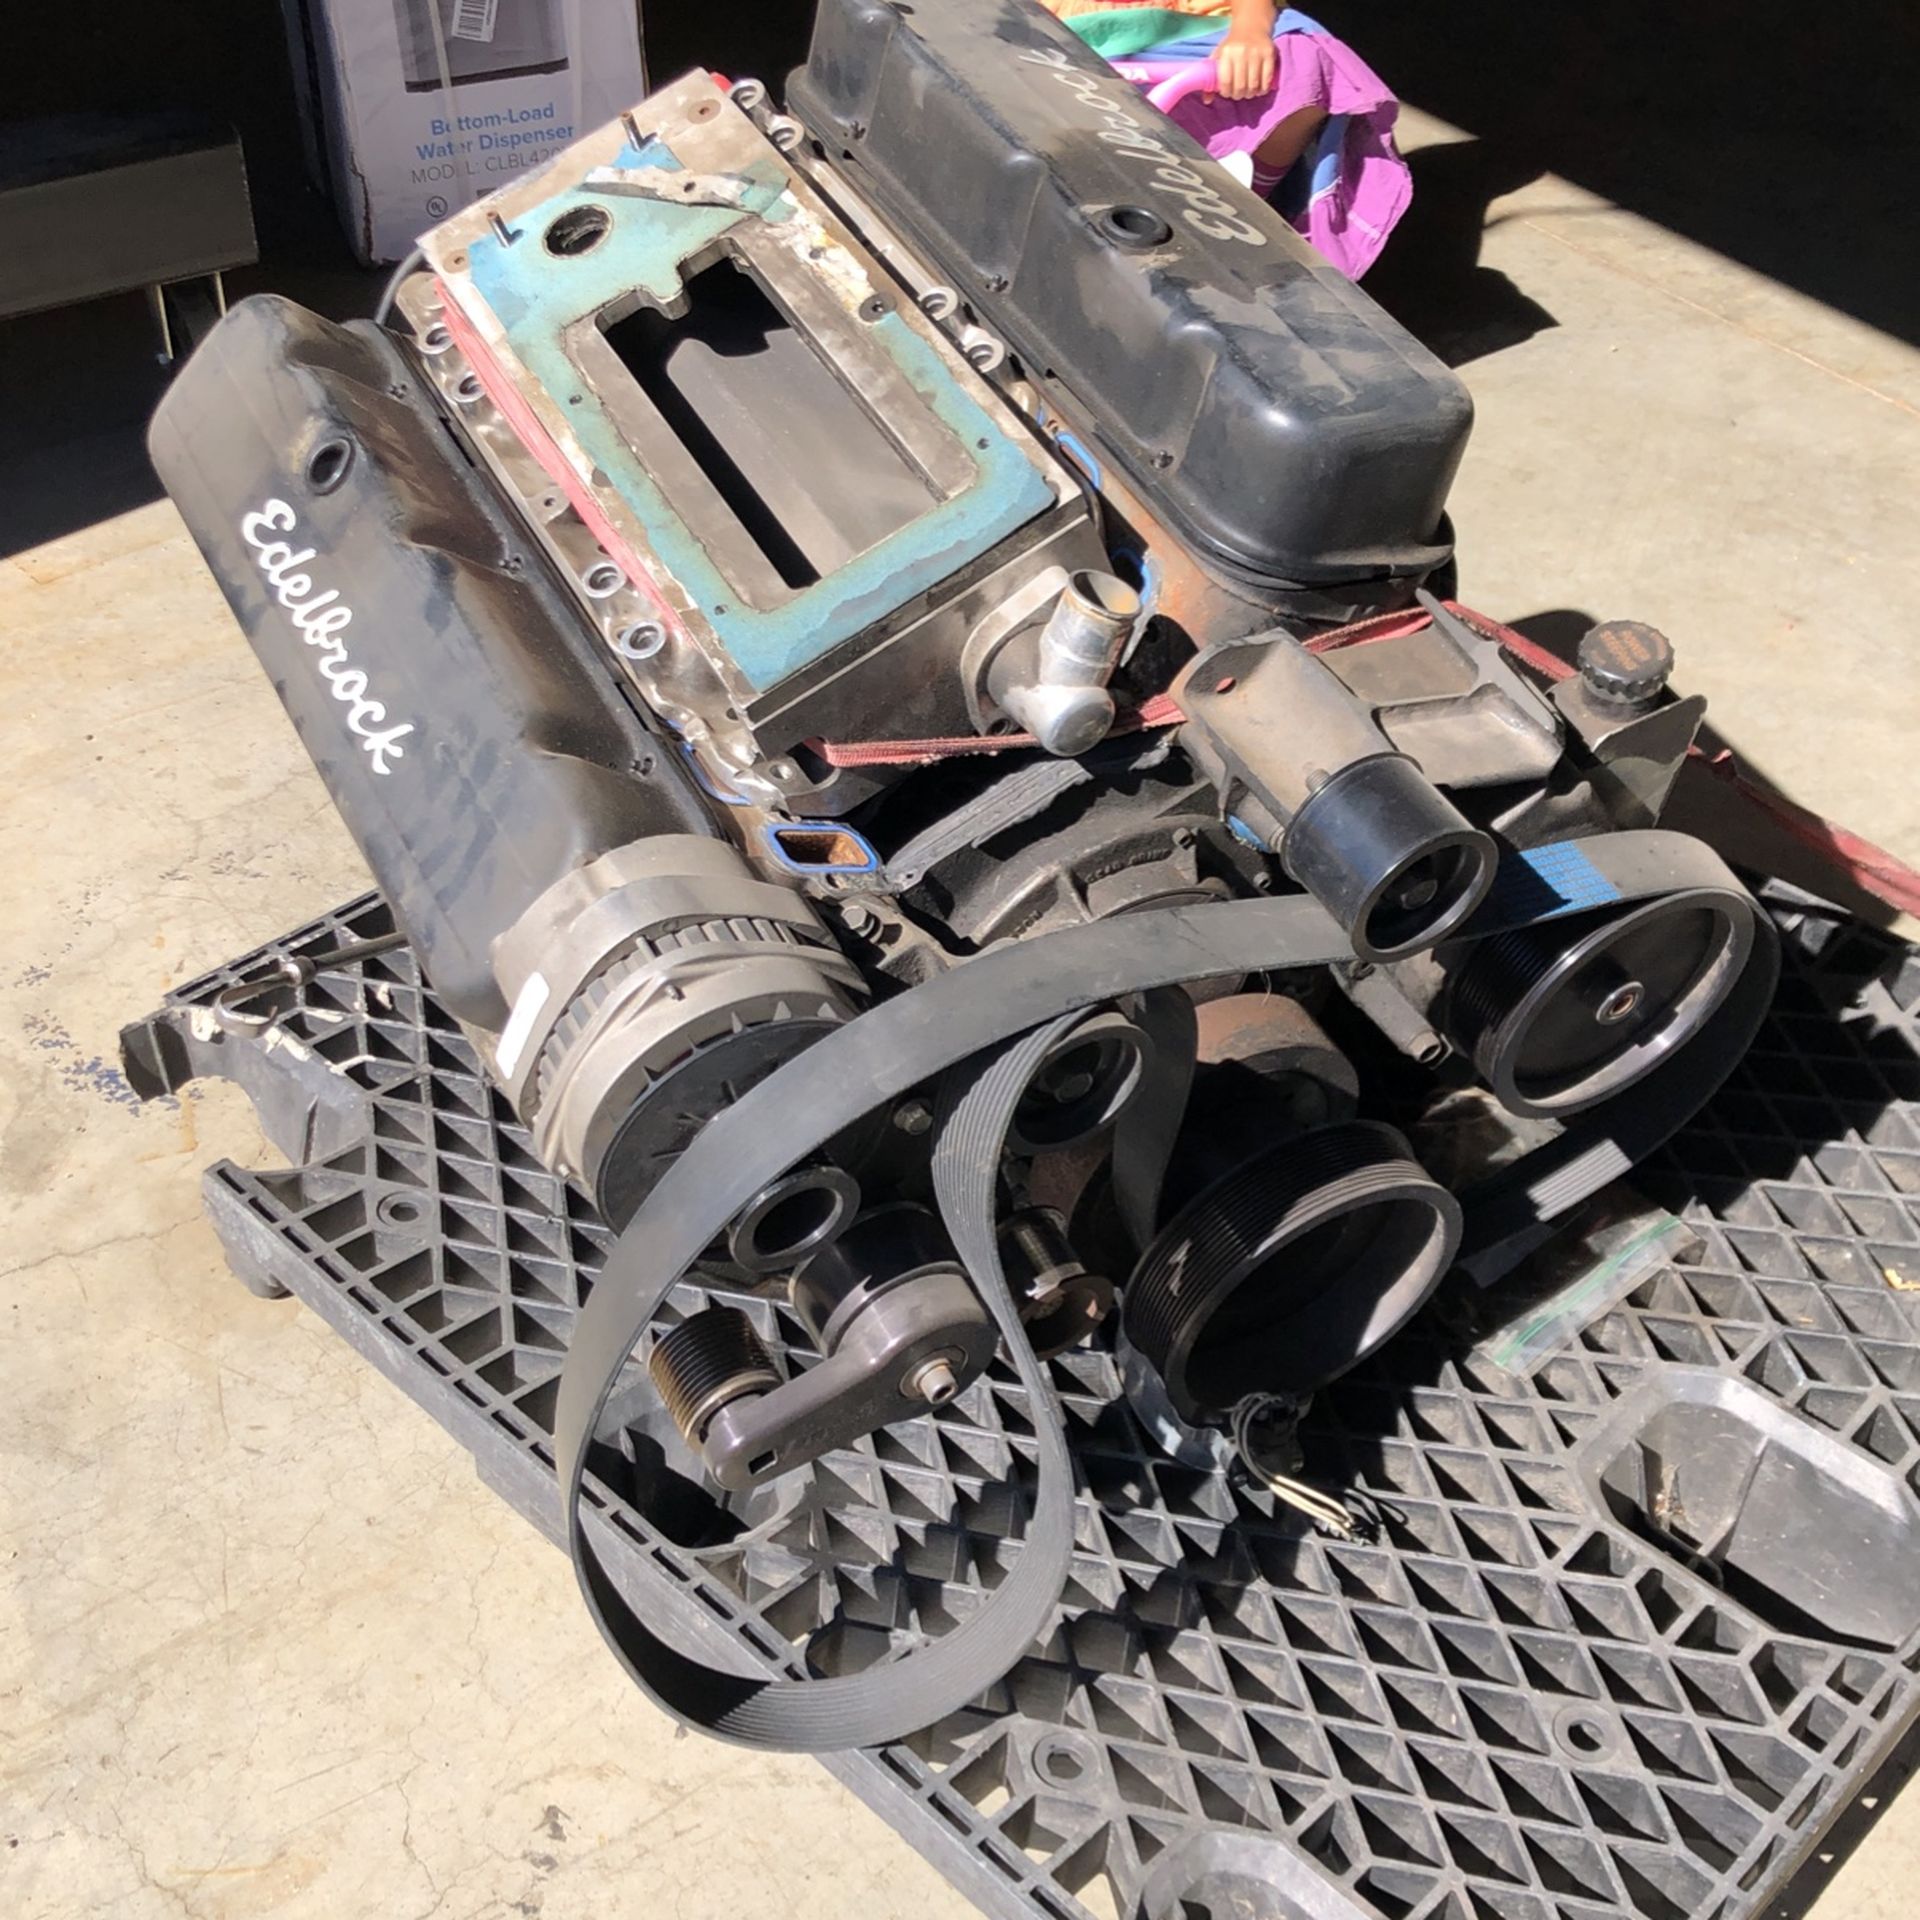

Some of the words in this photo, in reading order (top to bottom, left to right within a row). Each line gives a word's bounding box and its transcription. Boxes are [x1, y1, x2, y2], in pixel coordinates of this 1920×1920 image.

[411, 161, 480, 184] MODL:
[479, 126, 573, 150] Dispenser
[1018, 48, 1267, 246] Edelbrock
[242, 499, 414, 775] Edelbrock
